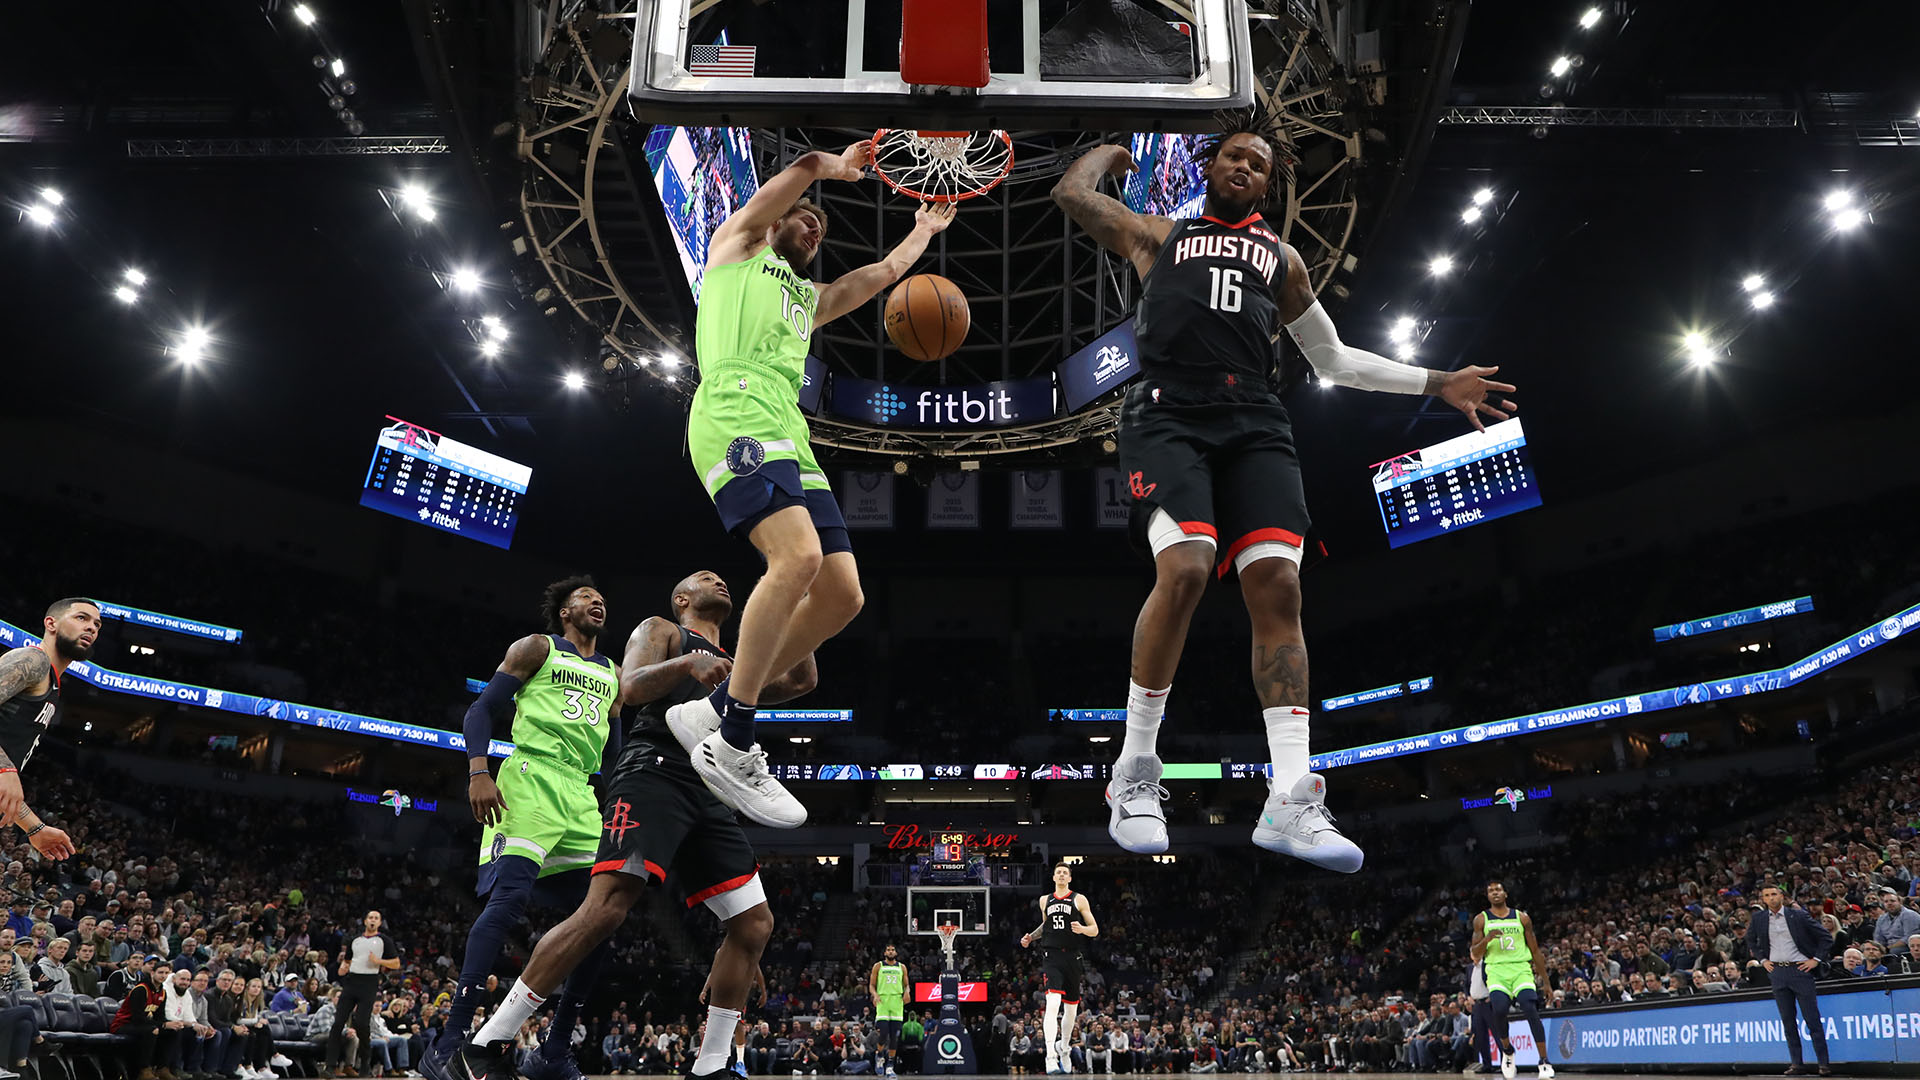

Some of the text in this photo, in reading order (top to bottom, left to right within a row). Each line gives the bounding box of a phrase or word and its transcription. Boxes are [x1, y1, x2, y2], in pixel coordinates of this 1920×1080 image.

[1174, 235, 1279, 286] HOUSTON
[1209, 267, 1243, 313] 16
[781, 284, 809, 342] 10
[917, 390, 1012, 423] fitbit
[431, 511, 460, 530] fitbit
[1453, 508, 1485, 526] fitbit
[1760, 600, 1796, 614] MONDAY
[137, 613, 165, 625] WATCH
[165, 618, 179, 627] THE
[180, 621, 210, 634] WOLVES
[210, 628, 224, 637] ON
[1701, 621, 1712, 629] VS
[0, 628, 14, 642] PM
[94, 671, 101, 682] &
[101, 674, 176, 696] STREAMING
[177, 688, 200, 701] ON
[1716, 684, 1732, 695] VS
[1790, 660, 1820, 681] MONDAY
[1821, 650, 1838, 666] 7:30
[1838, 645, 1851, 656] PM
[1859, 632, 1875, 648] ON
[1884, 622, 1898, 633] FOX
[551, 669, 611, 699] MINNESOTA
[1358, 693, 1377, 701] WATCH
[1377, 690, 1387, 698] THE
[1387, 687, 1402, 696] WOL
[561, 688, 603, 726] 33
[295, 709, 310, 721] VS
[359, 720, 402, 737] MONDAY
[403, 728, 423, 740] 7:30
[424, 731, 439, 742] PM
[449, 736, 466, 748] ON
[1359, 745, 1395, 759] MONDAY
[1397, 741, 1415, 752] 7:30
[1416, 739, 1429, 749] PM
[1440, 733, 1457, 744] ON
[1488, 722, 1520, 737] NORTH
[1527, 719, 1537, 729] &
[1538, 706, 1599, 727] STREAMING
[1601, 703, 1620, 715] ON
[902, 767, 915, 777] 17
[934, 765, 962, 776] 6:49
[983, 767, 997, 777] 10
[344, 787, 438, 812] Treasure Island
[1459, 784, 1552, 810] Treasure Island
[883, 824, 1019, 849] Bueser
[941, 834, 963, 844] 6:49
[944, 844, 961, 862] 19
[1047, 903, 1072, 916] HOUSTON
[1053, 915, 1064, 930] 55
[1499, 936, 1515, 950] 12
[885, 976, 898, 984] 32
[1510, 1035, 1532, 1050] YOTA
[1581, 1029, 1620, 1049] PROUD
[1623, 1025, 1677, 1047] PARTNER
[1680, 1024, 1699, 1045] OF
[1703, 1022, 1730, 1044] THE
